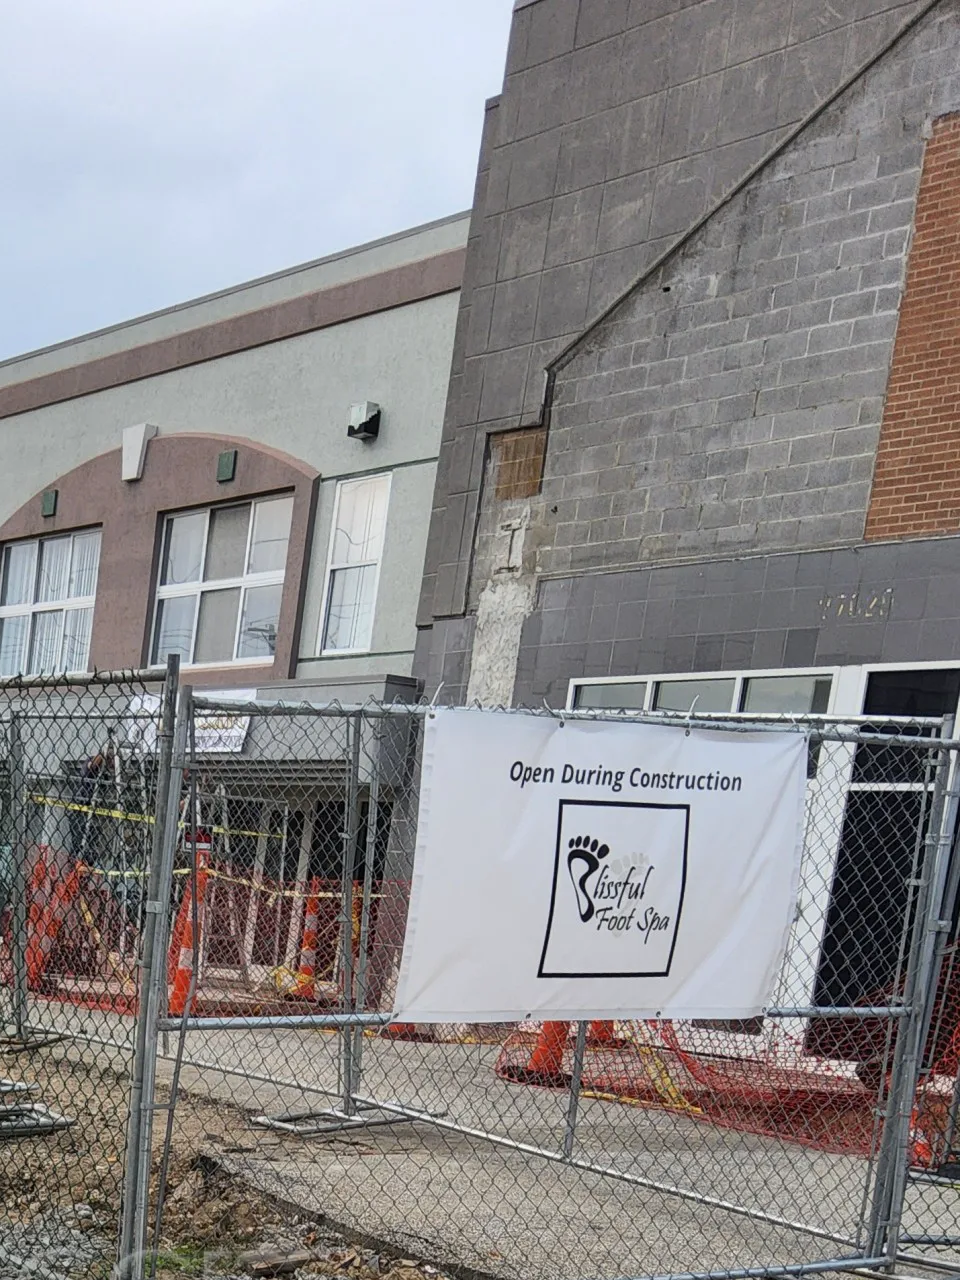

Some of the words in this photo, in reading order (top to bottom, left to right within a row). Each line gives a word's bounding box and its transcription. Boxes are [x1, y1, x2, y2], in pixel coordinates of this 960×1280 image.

[510, 761, 555, 788] Open
[561, 764, 625, 792] During
[629, 767, 742, 792] Construction
[594, 906, 637, 932] Foot
[636, 906, 671, 945] Spa
